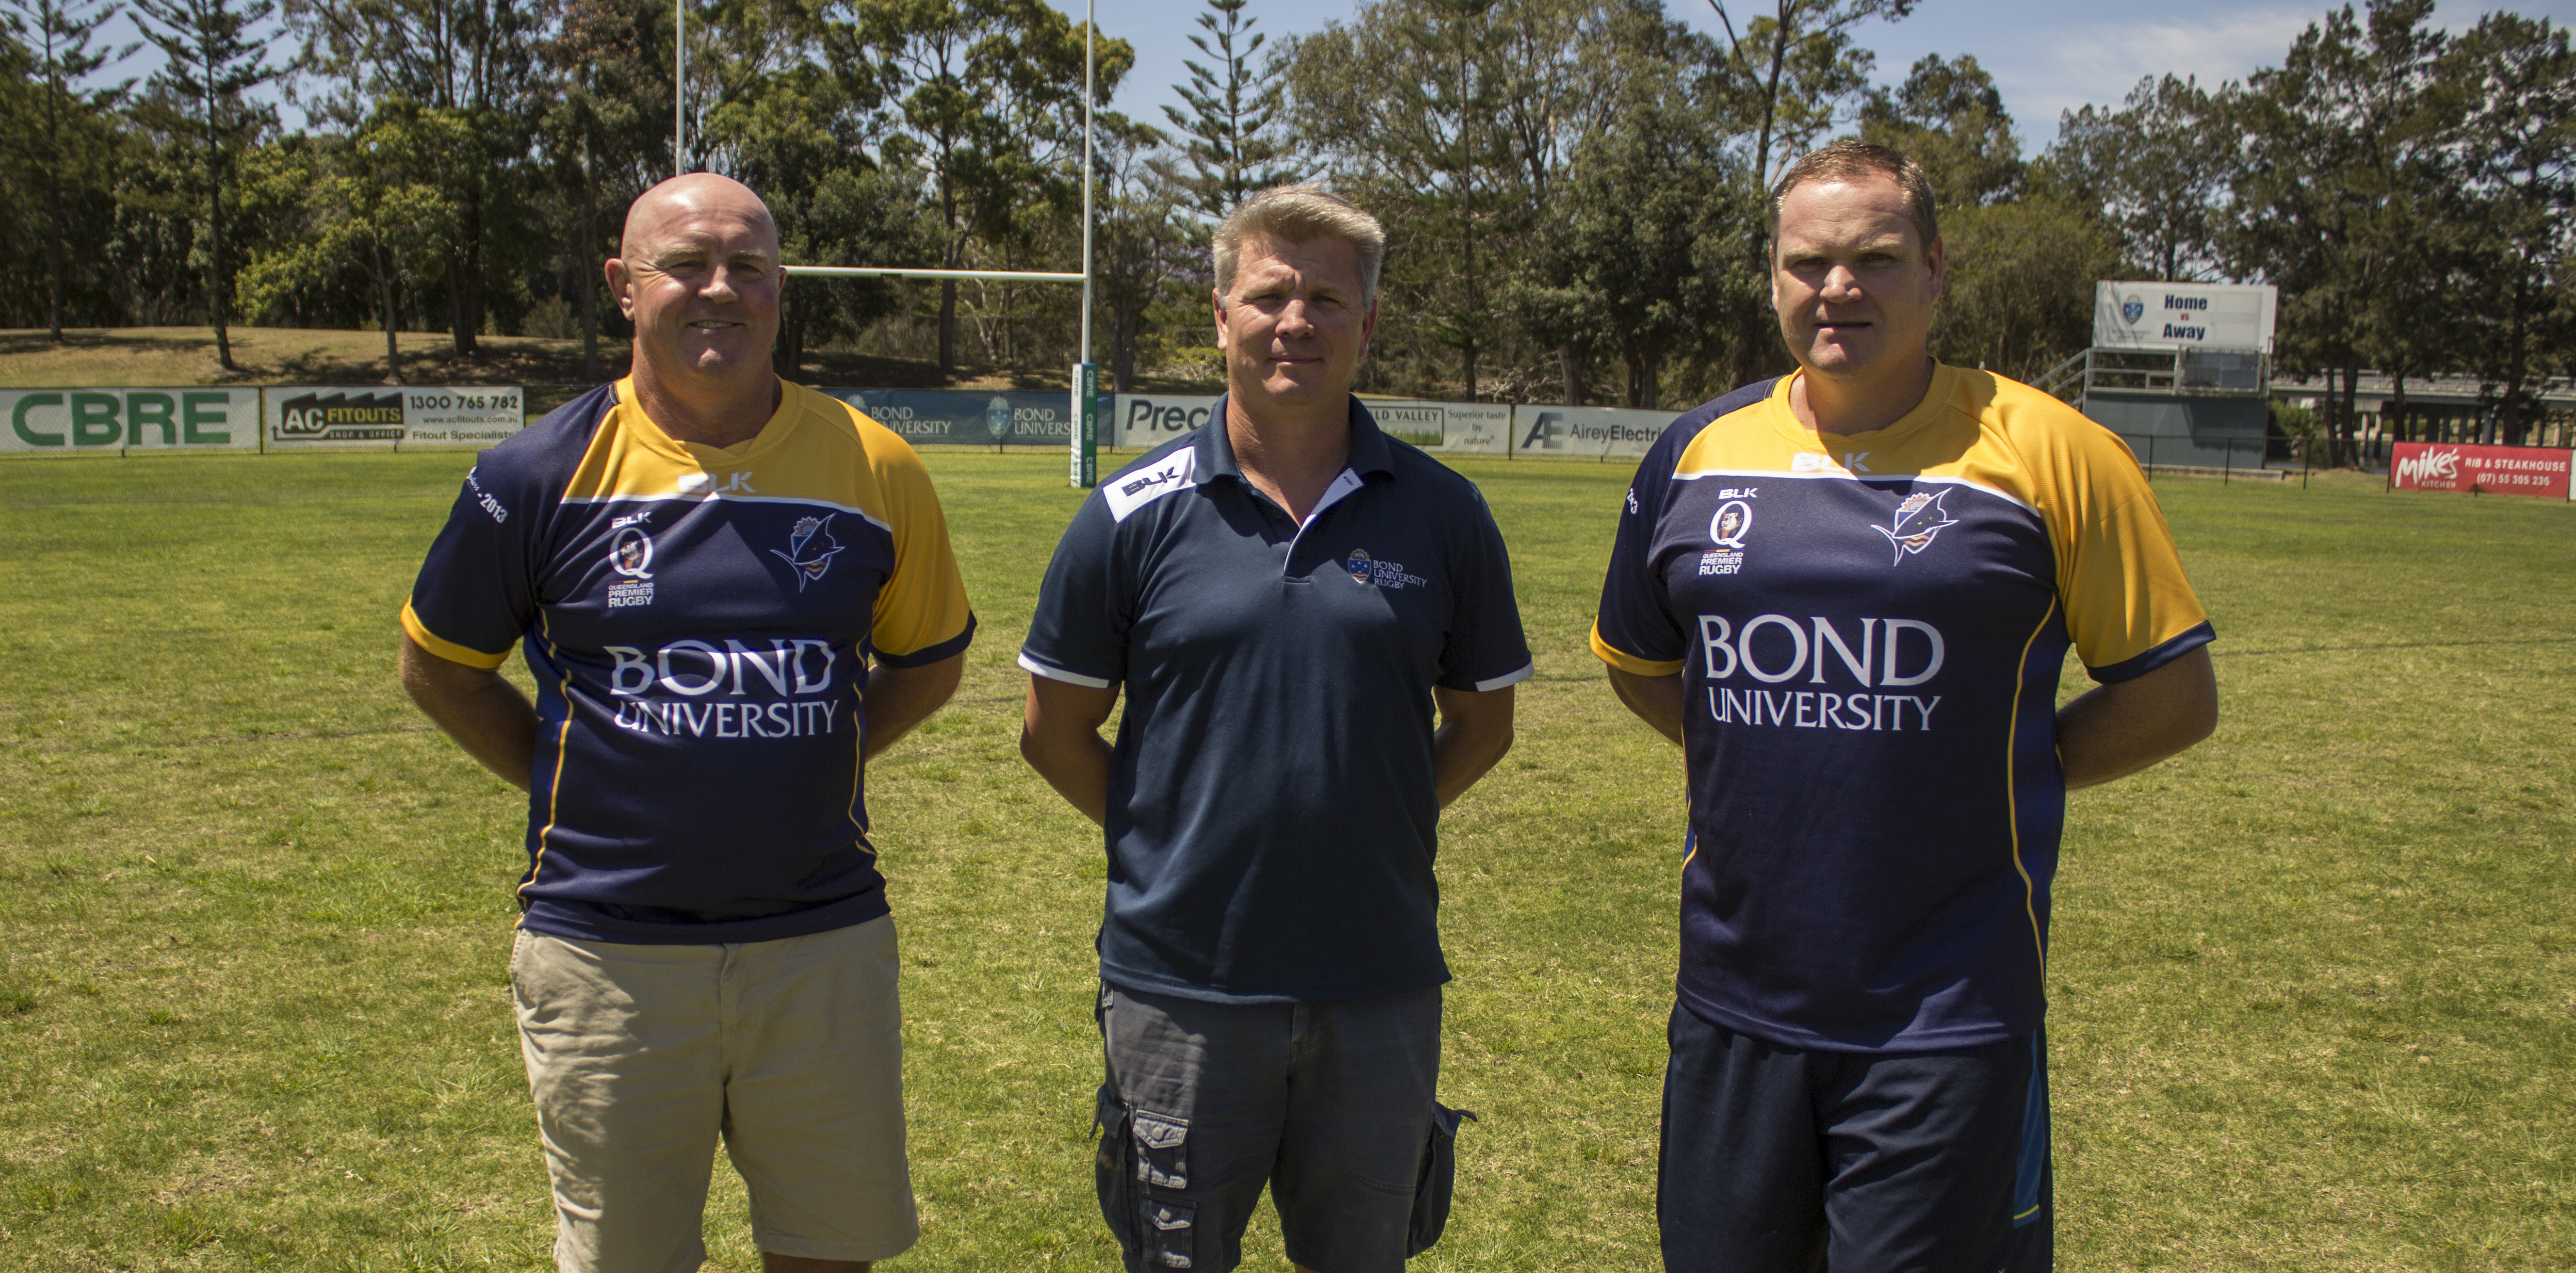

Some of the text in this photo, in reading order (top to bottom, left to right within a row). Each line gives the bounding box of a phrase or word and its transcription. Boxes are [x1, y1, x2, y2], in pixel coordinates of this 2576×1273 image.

[2164, 294, 2207, 311] Home
[2163, 323, 2205, 341] Away
[410, 395, 518, 409] 1300 765 782
[12, 392, 231, 446] CBRE
[285, 408, 401, 431] AC FITOUTS
[871, 406, 913, 419] BOND
[1014, 408, 1055, 421] BOND
[1395, 410, 1438, 421] VALLEY
[1448, 409, 1506, 420] Superior taste
[879, 420, 950, 434] NIVERSITY
[1472, 423, 1482, 433] by
[412, 431, 447, 440] Fitout
[1791, 452, 1871, 472] BLK
[2465, 457, 2566, 472] RIB & STEAKHOUSE
[678, 472, 755, 492] BLK
[1122, 467, 1181, 497] BLK
[2421, 480, 2456, 489] KITCHEN
[2477, 473, 2550, 486] (07) 55 305 236
[1718, 488, 1758, 499] BLK
[612, 512, 651, 529] BLK
[1710, 500, 1752, 548] Q
[610, 527, 653, 579] Q
[1374, 560, 1403, 572] BOND
[1699, 564, 1741, 575] RUGBY
[1374, 569, 1427, 587] UNIVERSITY
[1374, 578, 1404, 589] RUGBY
[608, 588, 653, 598] PREMIER
[608, 595, 653, 608] RUGBY
[1697, 614, 1945, 687] BOND
[603, 639, 836, 696] BOND
[1708, 687, 1942, 731] UNIVERSITY
[614, 700, 838, 737] UNIVERSITY
